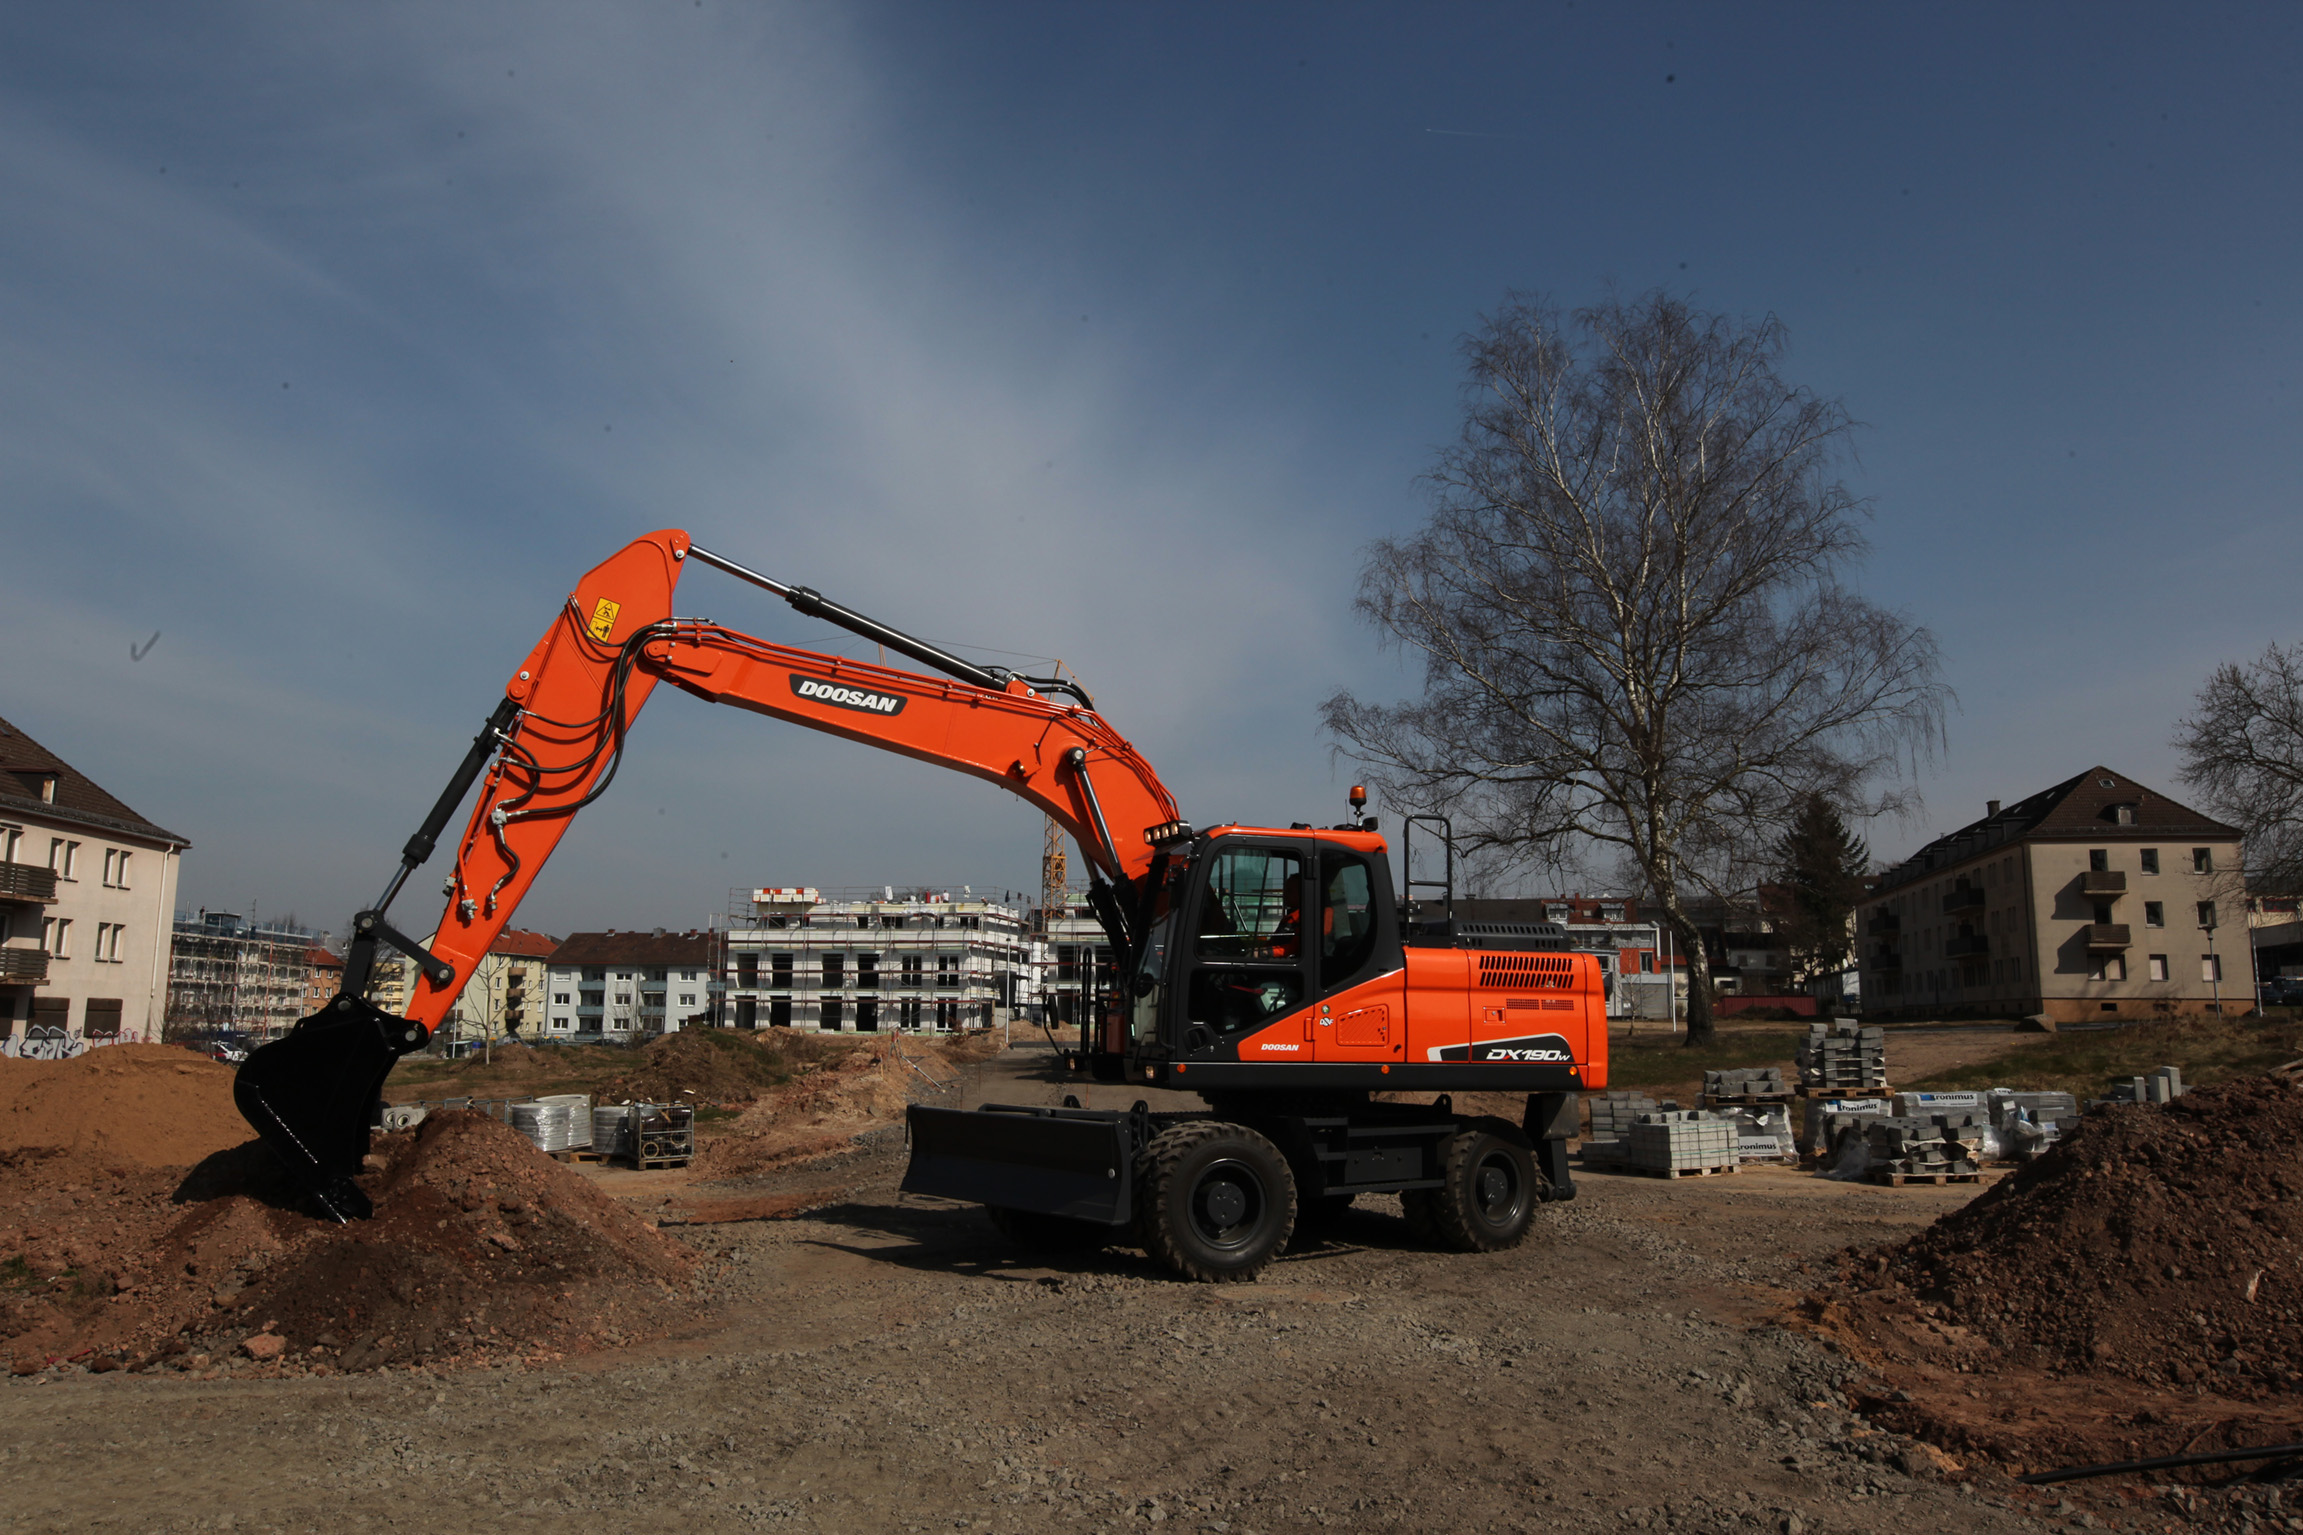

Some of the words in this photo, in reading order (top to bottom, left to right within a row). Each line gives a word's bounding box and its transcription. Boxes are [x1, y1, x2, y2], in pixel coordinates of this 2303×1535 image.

[798, 680, 898, 712] DOOSAN
[1261, 1043, 1299, 1051] DOOSAN
[1738, 1142, 1777, 1151] ronimus
